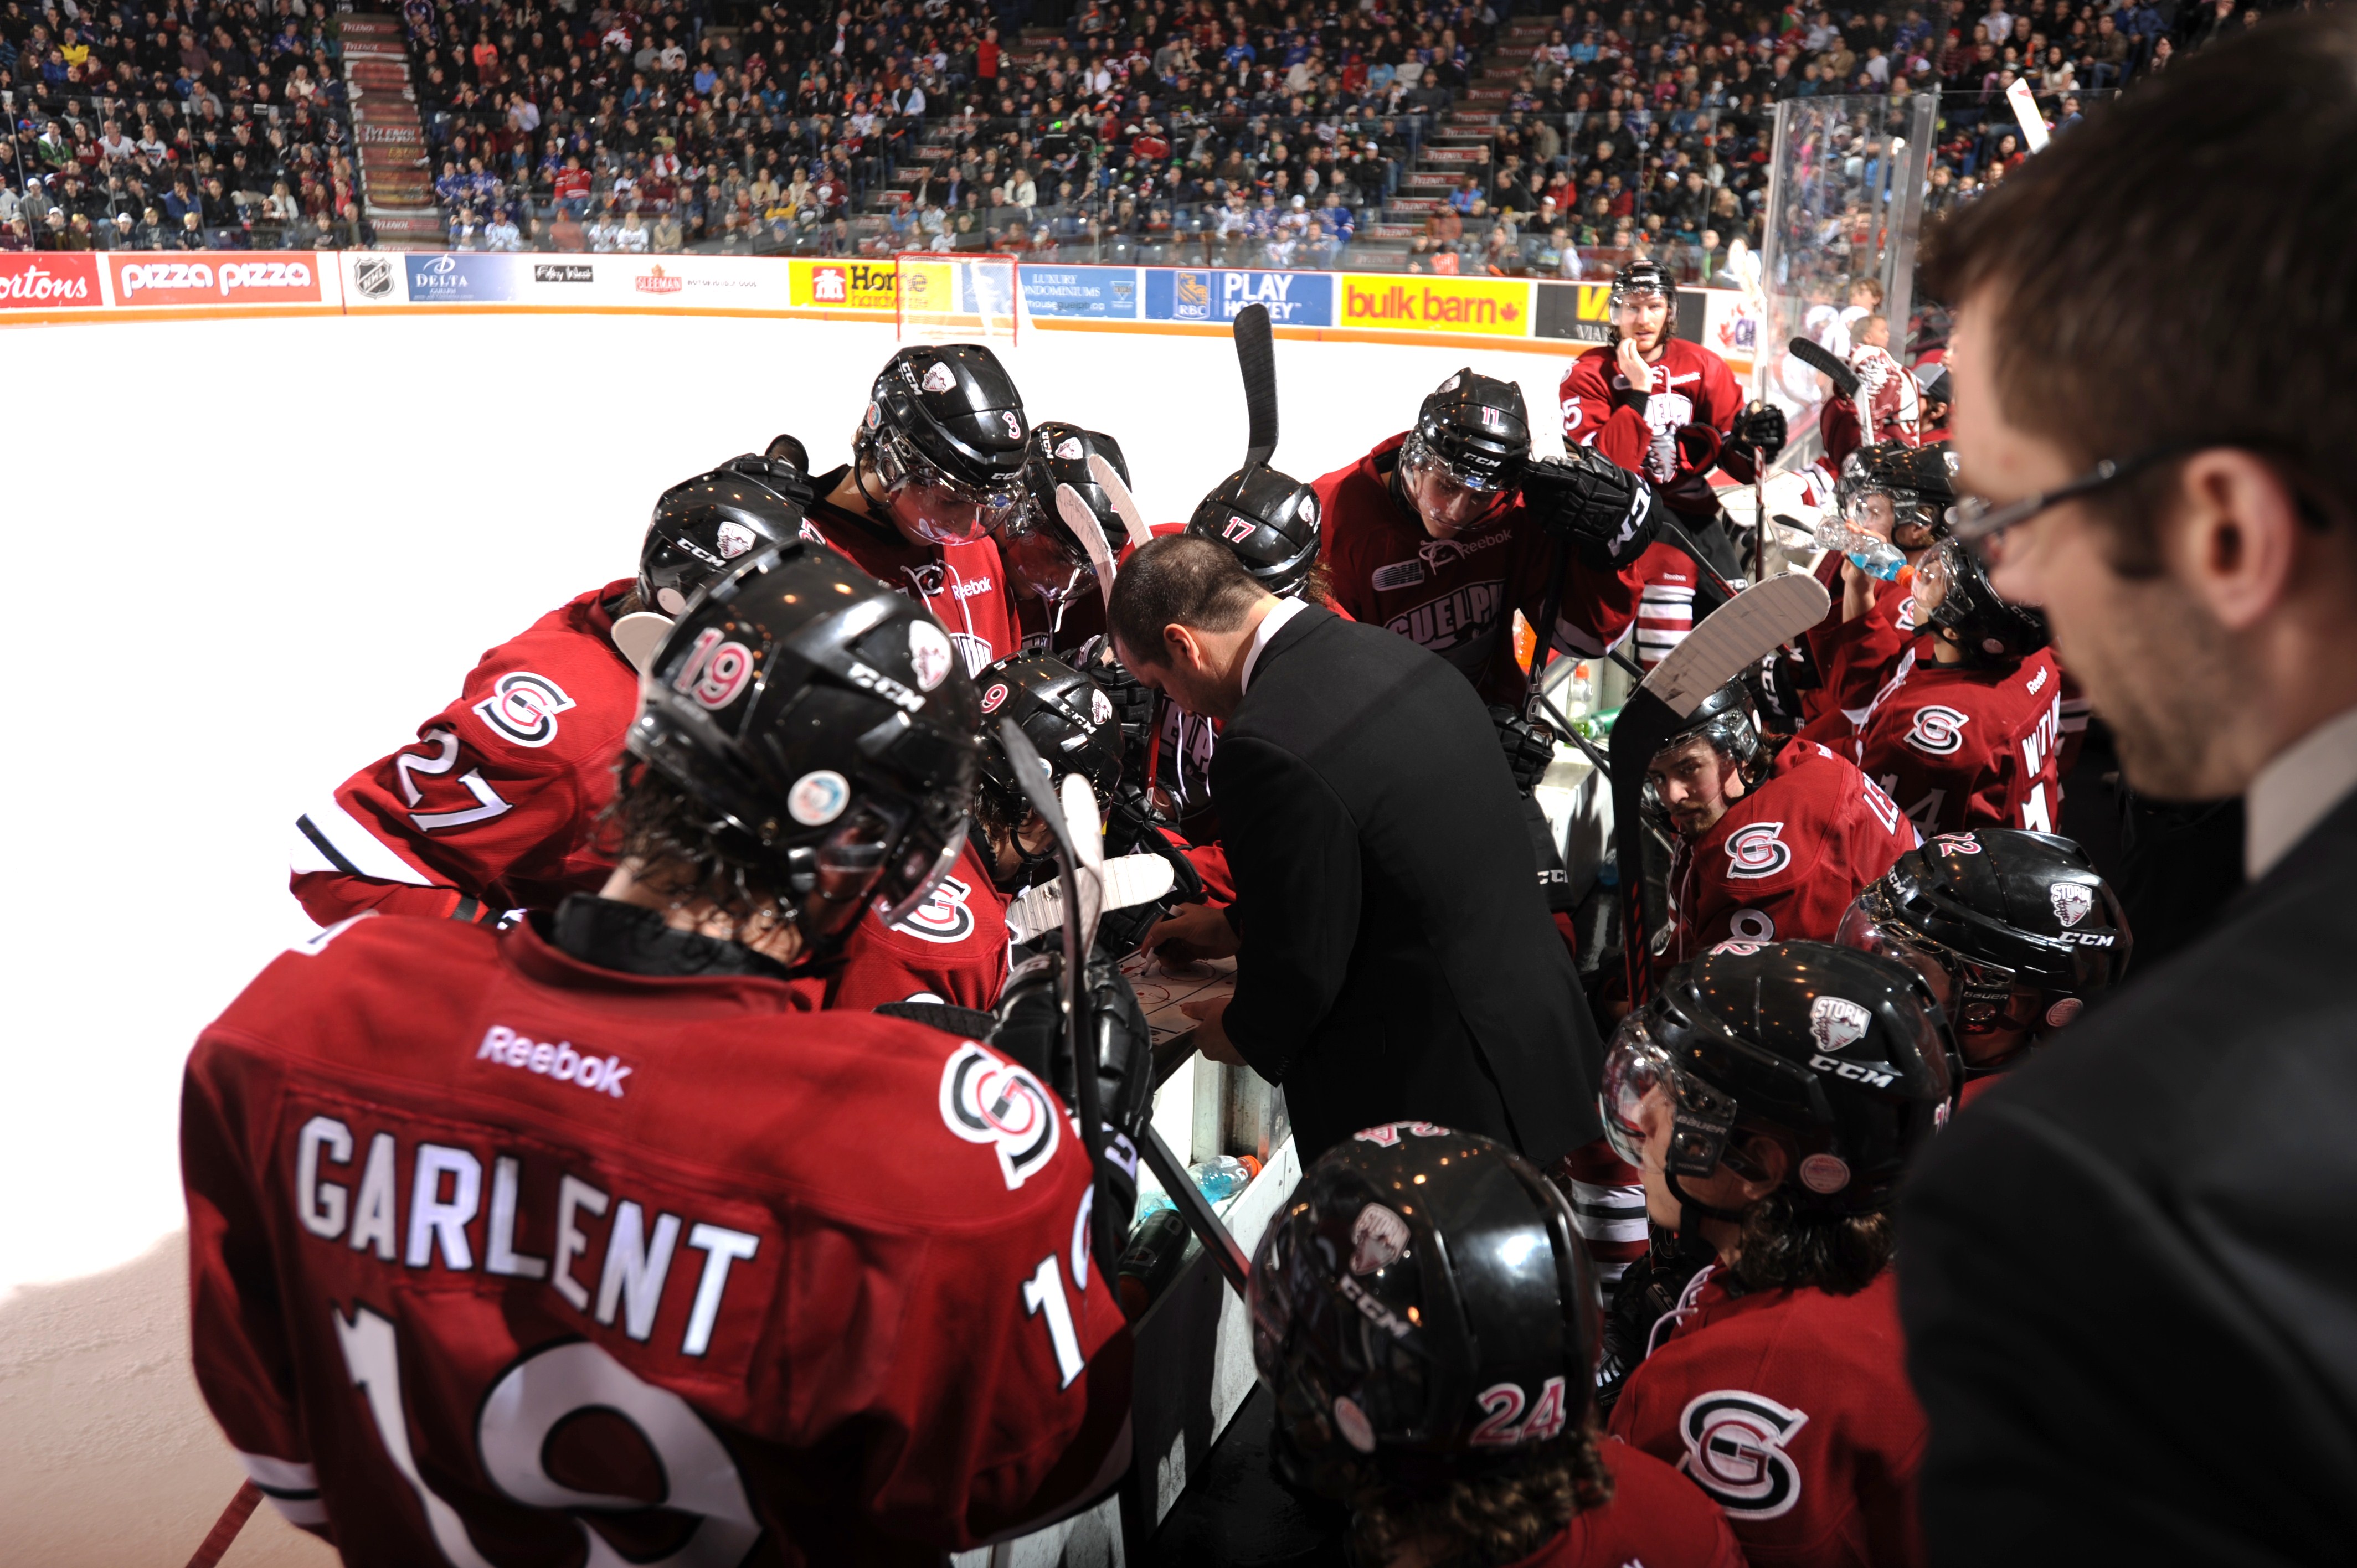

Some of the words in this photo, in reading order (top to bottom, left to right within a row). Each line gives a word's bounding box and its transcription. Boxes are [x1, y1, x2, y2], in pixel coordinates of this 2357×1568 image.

[343, 22, 376, 32] TYLENOL
[345, 41, 379, 51] TYLENOL
[371, 219, 409, 230] TYLENOL
[121, 264, 214, 298] pizza
[218, 262, 311, 296] pizza
[362, 267, 384, 291] NHL
[416, 273, 469, 287] DELTA
[637, 277, 681, 290] SLEEMAN
[1224, 272, 1294, 301] PLAY
[1179, 305, 1206, 316] RBC
[1348, 284, 1418, 319] bulk
[1423, 287, 1497, 324] barn
[902, 360, 923, 395] CCM
[1002, 411, 1021, 439] 3
[1481, 406, 1500, 425] 11
[1463, 452, 1501, 468] CCM
[1222, 516, 1256, 544] 17
[1461, 529, 1512, 555] Reebok
[676, 537, 727, 568] CCM
[951, 576, 992, 600] Reebok
[2010, 605, 2041, 628] CCM
[673, 627, 754, 711] 19
[980, 683, 1008, 714] 9
[397, 728, 514, 832] 27
[2052, 886, 2091, 904] STORM
[2057, 931, 2115, 947] CCM
[1813, 998, 1872, 1029] STORM
[477, 1025, 633, 1099] Reebok
[1807, 1053, 1895, 1089] CCM
[295, 1114, 760, 1358] GARLENT
[1471, 1376, 1567, 1446] 24
[332, 1308, 763, 1568] 19
